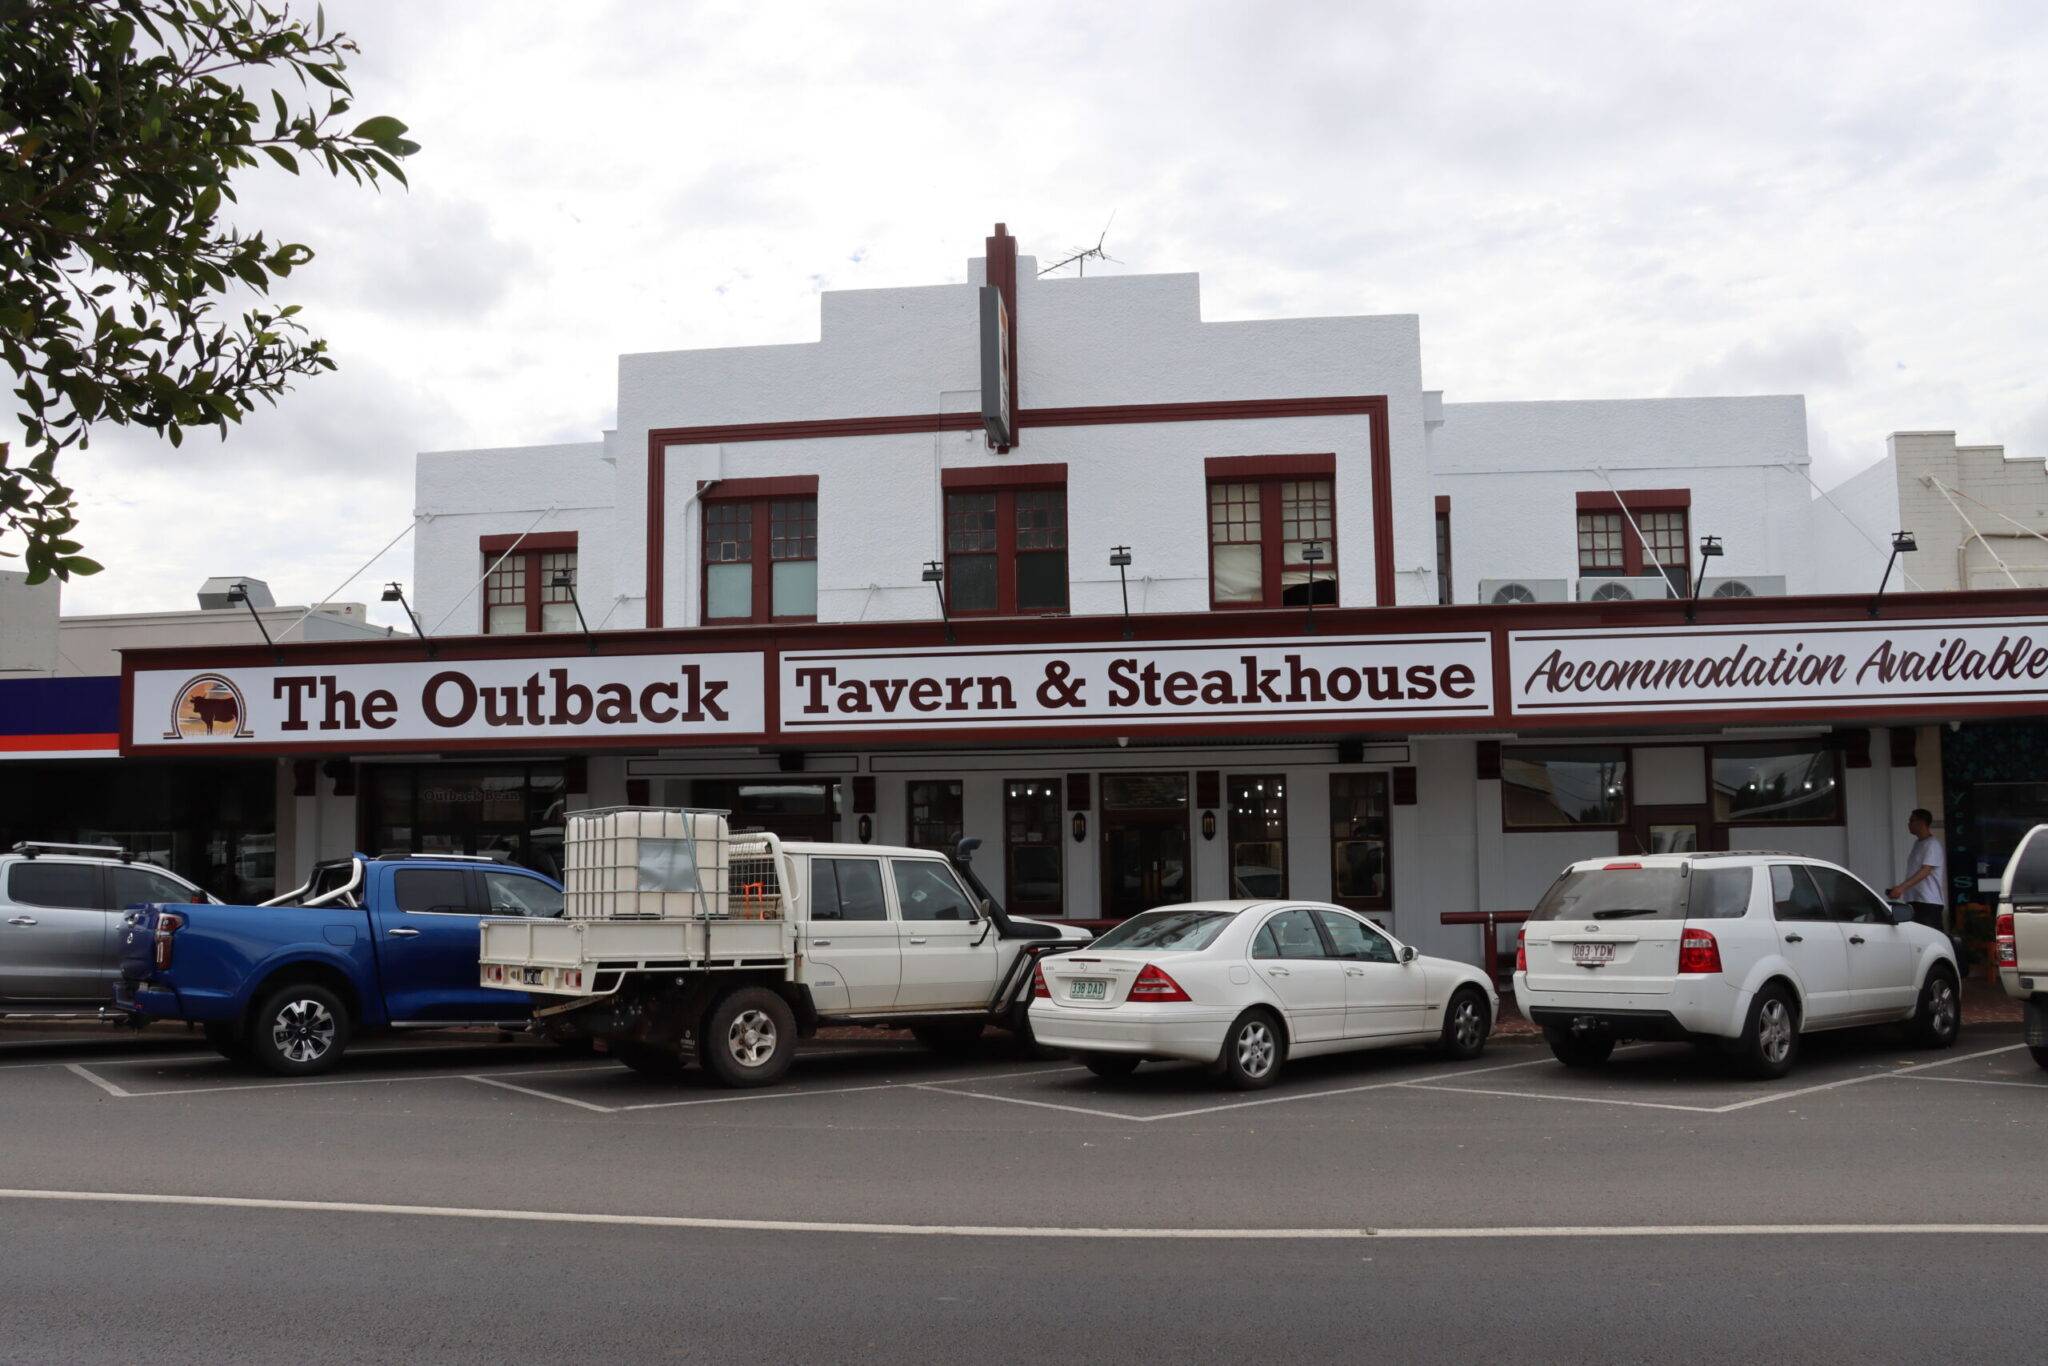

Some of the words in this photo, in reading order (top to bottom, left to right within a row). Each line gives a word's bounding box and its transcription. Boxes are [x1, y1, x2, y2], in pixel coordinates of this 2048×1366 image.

[795, 666, 1017, 714] Tavern
[1035, 659, 1087, 709] &
[1107, 654, 1476, 708] Steakhouse
[1524, 643, 1847, 695] Accommodation
[1855, 635, 2048, 686] Available
[272, 675, 399, 732] The
[421, 664, 730, 728] Outback
[1574, 944, 1591, 957] 083
[1594, 944, 1614, 957] YDW
